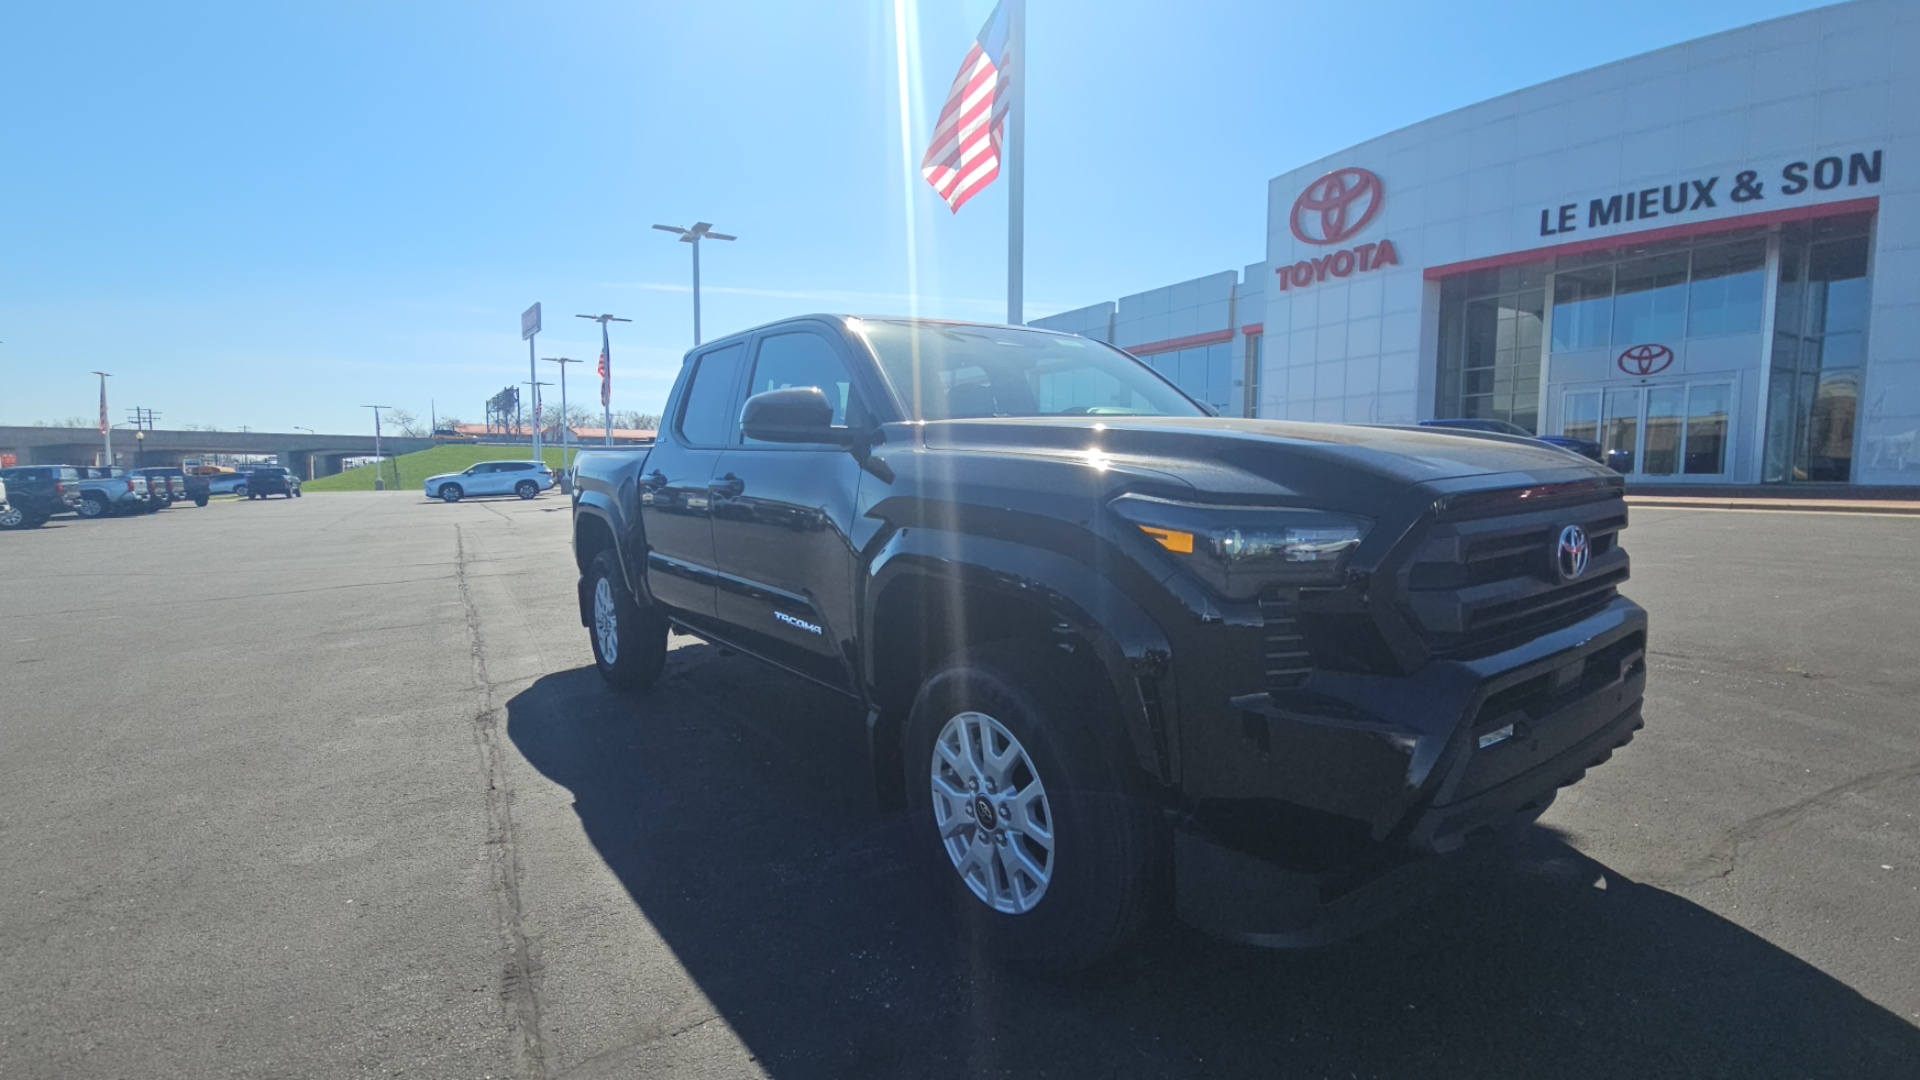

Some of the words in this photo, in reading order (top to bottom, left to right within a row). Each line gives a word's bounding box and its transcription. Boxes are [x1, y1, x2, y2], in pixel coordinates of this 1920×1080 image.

[1540, 203, 1577, 236] LE
[1588, 176, 1720, 228] MIEUX
[1730, 170, 1764, 203] &
[1781, 149, 1882, 195] SON
[1275, 239, 1399, 291] TOYOTA
[774, 610, 822, 635] TACOMA
